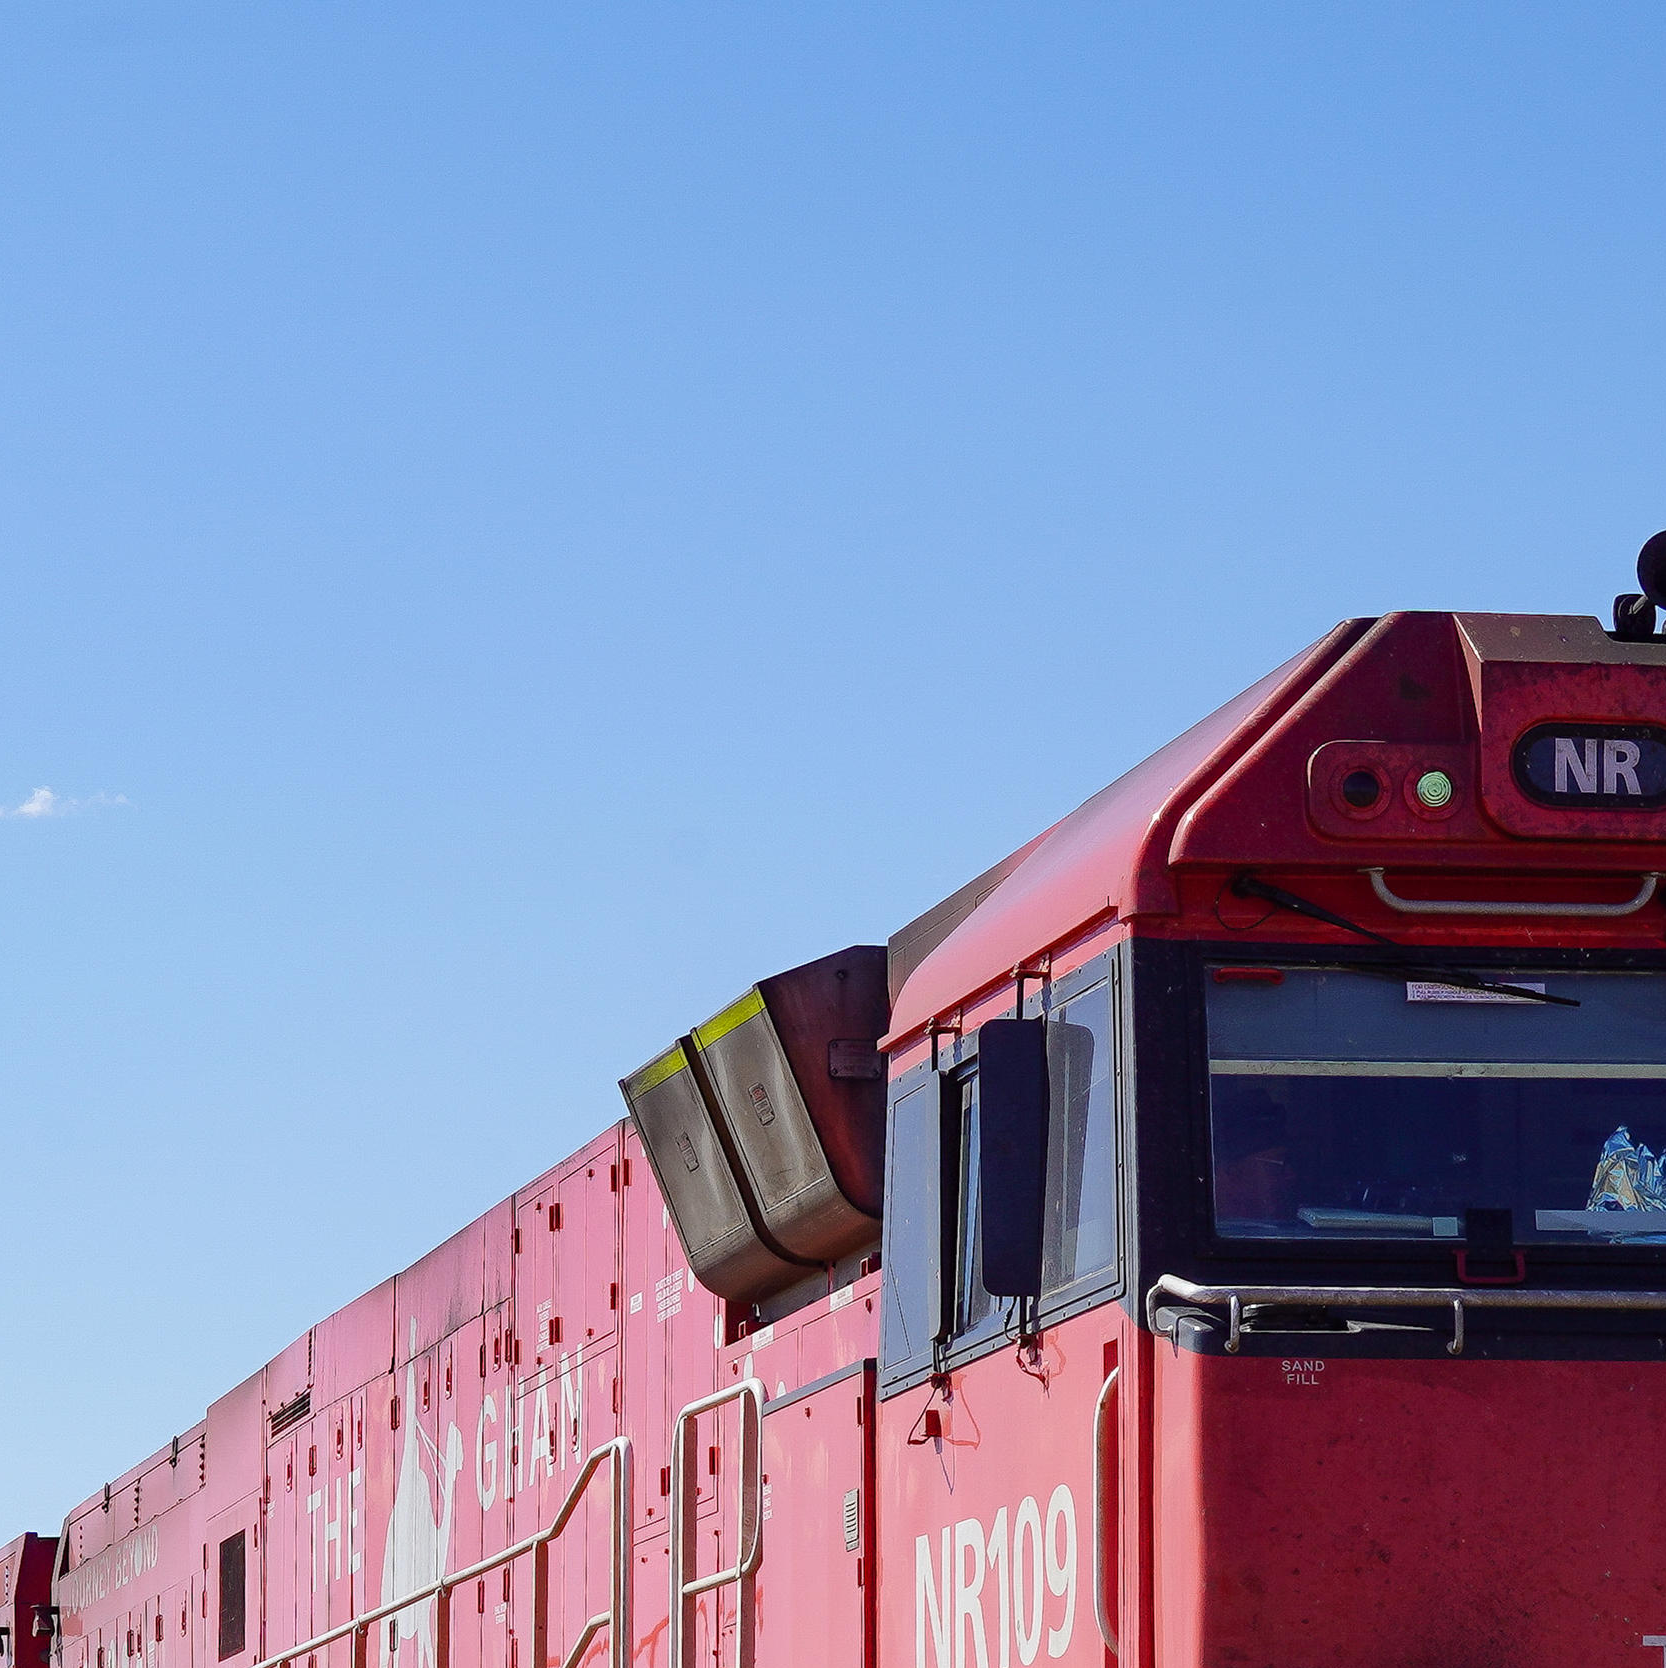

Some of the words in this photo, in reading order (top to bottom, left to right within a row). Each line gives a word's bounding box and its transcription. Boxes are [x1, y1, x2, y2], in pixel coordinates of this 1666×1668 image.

[1555, 738, 1642, 795] NR
[1281, 1360, 1325, 1371] SAND
[1287, 1373, 1320, 1385] FILL
[307, 1466, 362, 1593] THE
[476, 1342, 584, 1512] GHAN
